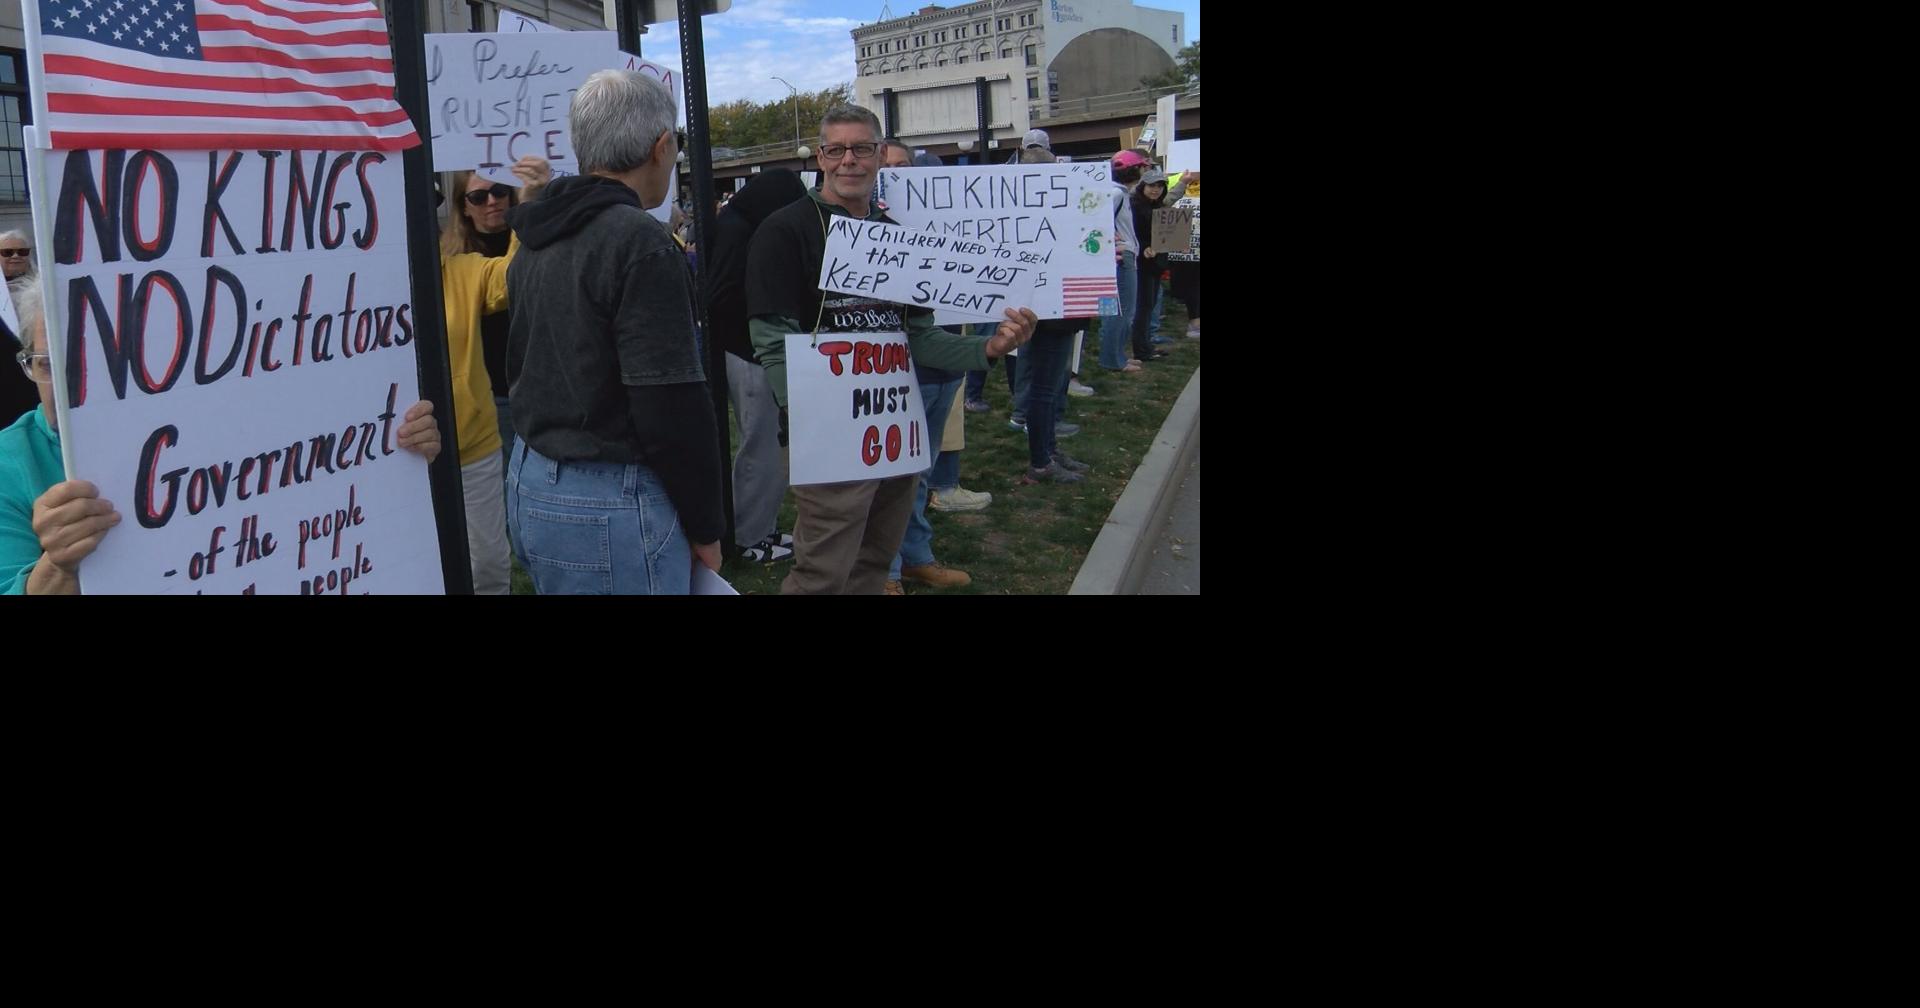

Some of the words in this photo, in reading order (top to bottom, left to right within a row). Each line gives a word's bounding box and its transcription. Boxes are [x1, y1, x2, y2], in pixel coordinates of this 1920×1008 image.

[473, 38, 574, 100] Prefer
[430, 89, 568, 136] RUSHE
[474, 130, 565, 168] ICE
[53, 150, 179, 264] NO
[201, 150, 386, 256] KINGS
[828, 220, 863, 249] MY
[951, 241, 987, 256] NEED
[825, 257, 889, 293] KEEP
[919, 257, 936, 269] I
[943, 261, 975, 274] DID
[976, 265, 1028, 286] NOT
[67, 269, 193, 408] NO
[853, 386, 910, 419] MUST
[134, 383, 398, 529] Government
[188, 526, 227, 581] of
[234, 514, 278, 568] the
[297, 484, 365, 569] people
